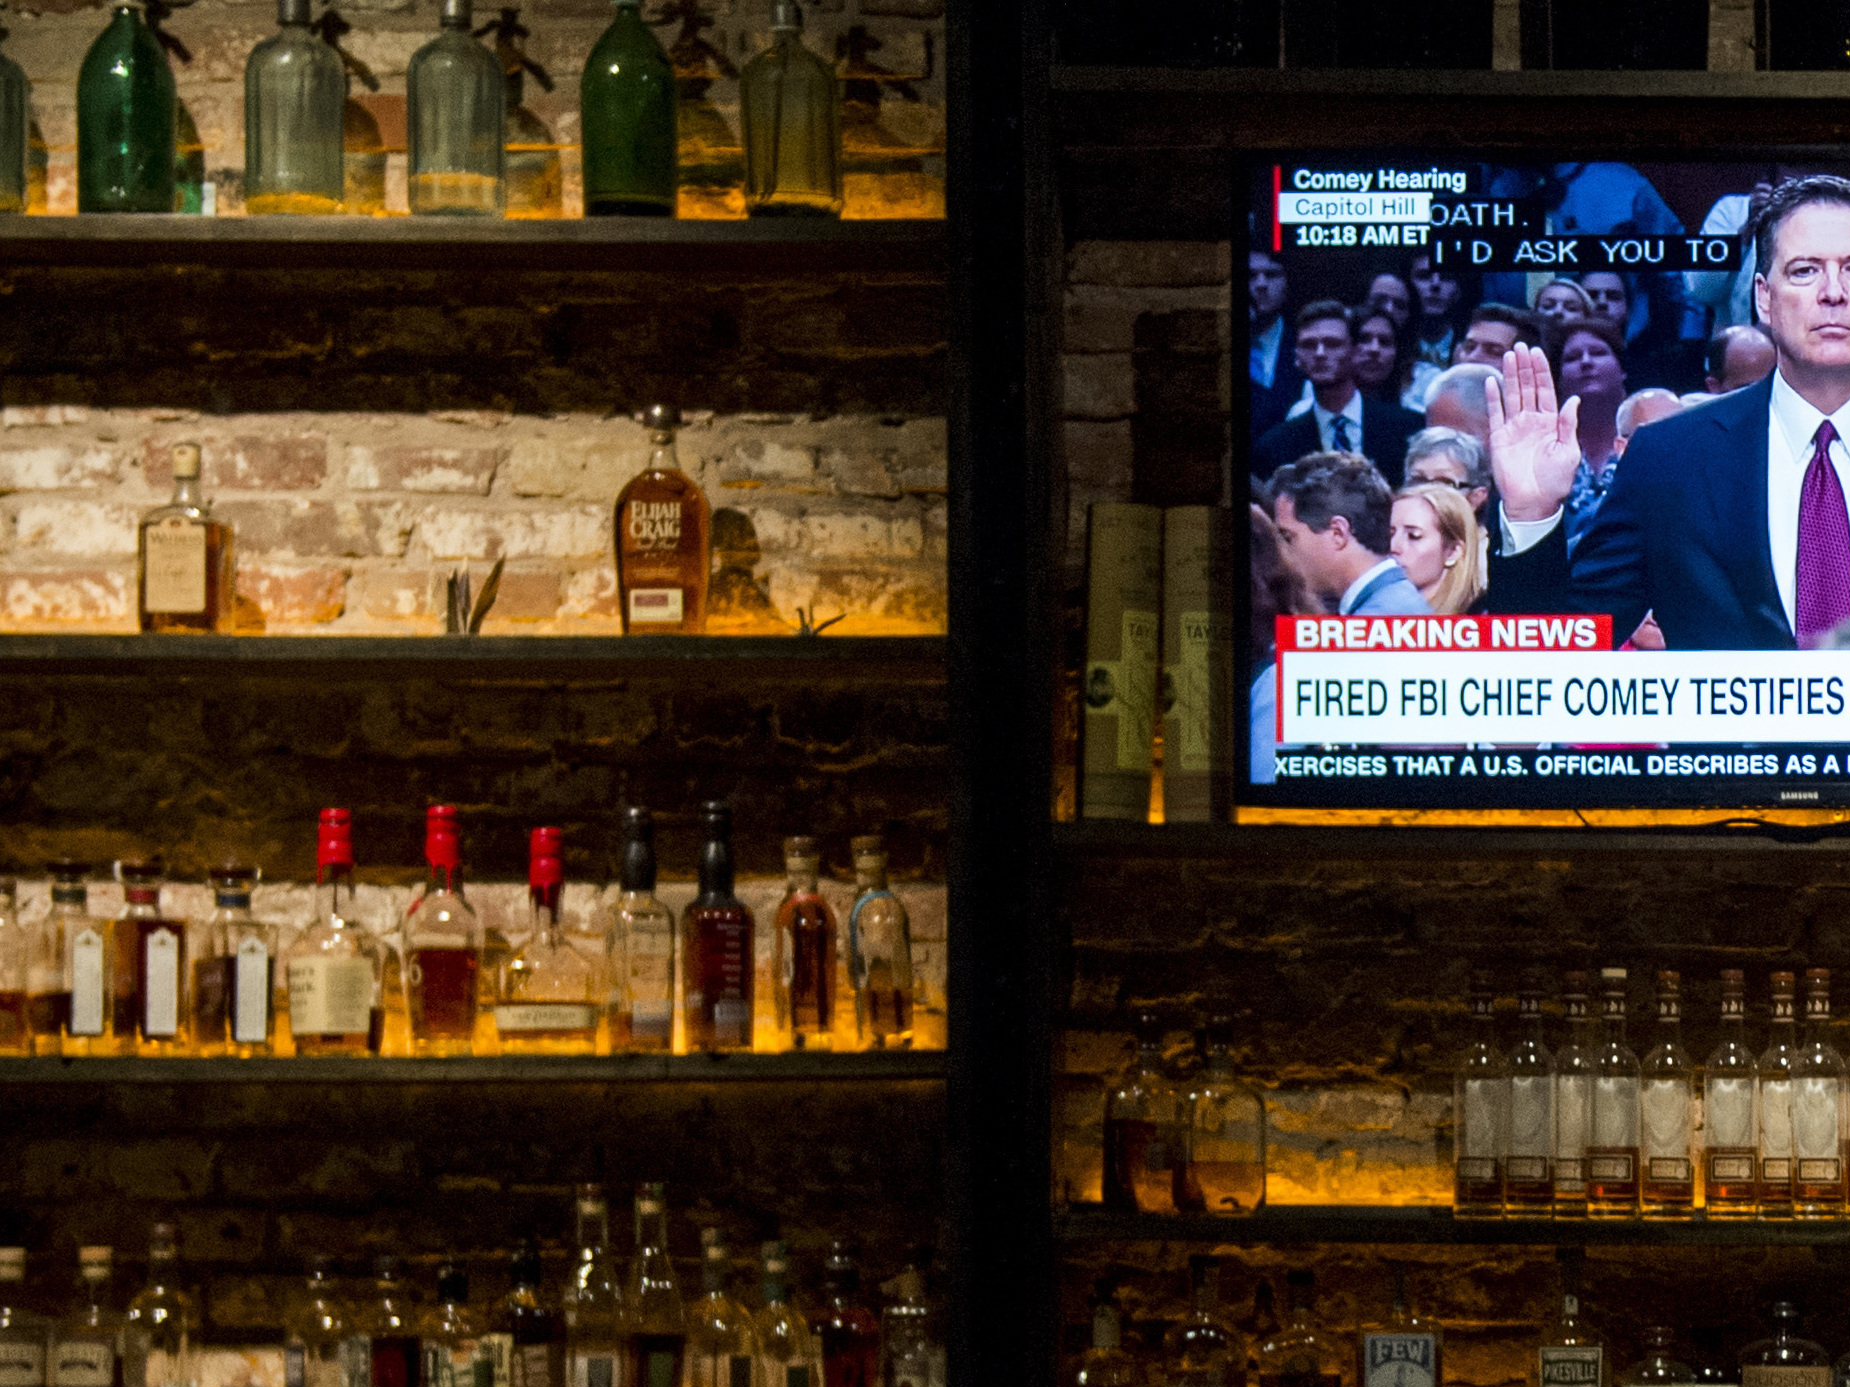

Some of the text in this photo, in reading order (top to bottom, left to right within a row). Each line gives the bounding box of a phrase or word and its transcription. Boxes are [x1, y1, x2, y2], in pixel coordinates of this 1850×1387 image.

[1294, 168, 1467, 194] Comey Hearing
[1295, 197, 1416, 218] Capitol Hill
[1430, 204, 1529, 226] OATH.
[1297, 225, 1430, 246] 10:18 AM ET
[1435, 239, 1729, 264] I'D ASK YOU TO
[630, 500, 681, 520] ELIJAH
[629, 520, 681, 539] CRAIG
[1295, 619, 1597, 648] BREAKING NEWS
[1296, 678, 1388, 717] FIRED
[1400, 678, 1448, 717] FBI
[1459, 677, 1553, 717] CHIEF
[1563, 677, 1680, 717] COMEY
[1690, 676, 1844, 716] TESTIFIES
[1275, 757, 1387, 777] XERCISES
[1393, 757, 1454, 776] THAT
[1460, 757, 1479, 776] A
[1482, 756, 1528, 776] U.S.
[1535, 756, 1640, 776] OFFICIAL
[1647, 755, 1779, 775] DESCRIBES
[1785, 755, 1818, 775] AS
[1823, 755, 1841, 774] A
[1374, 1339, 1426, 1364] FEW
